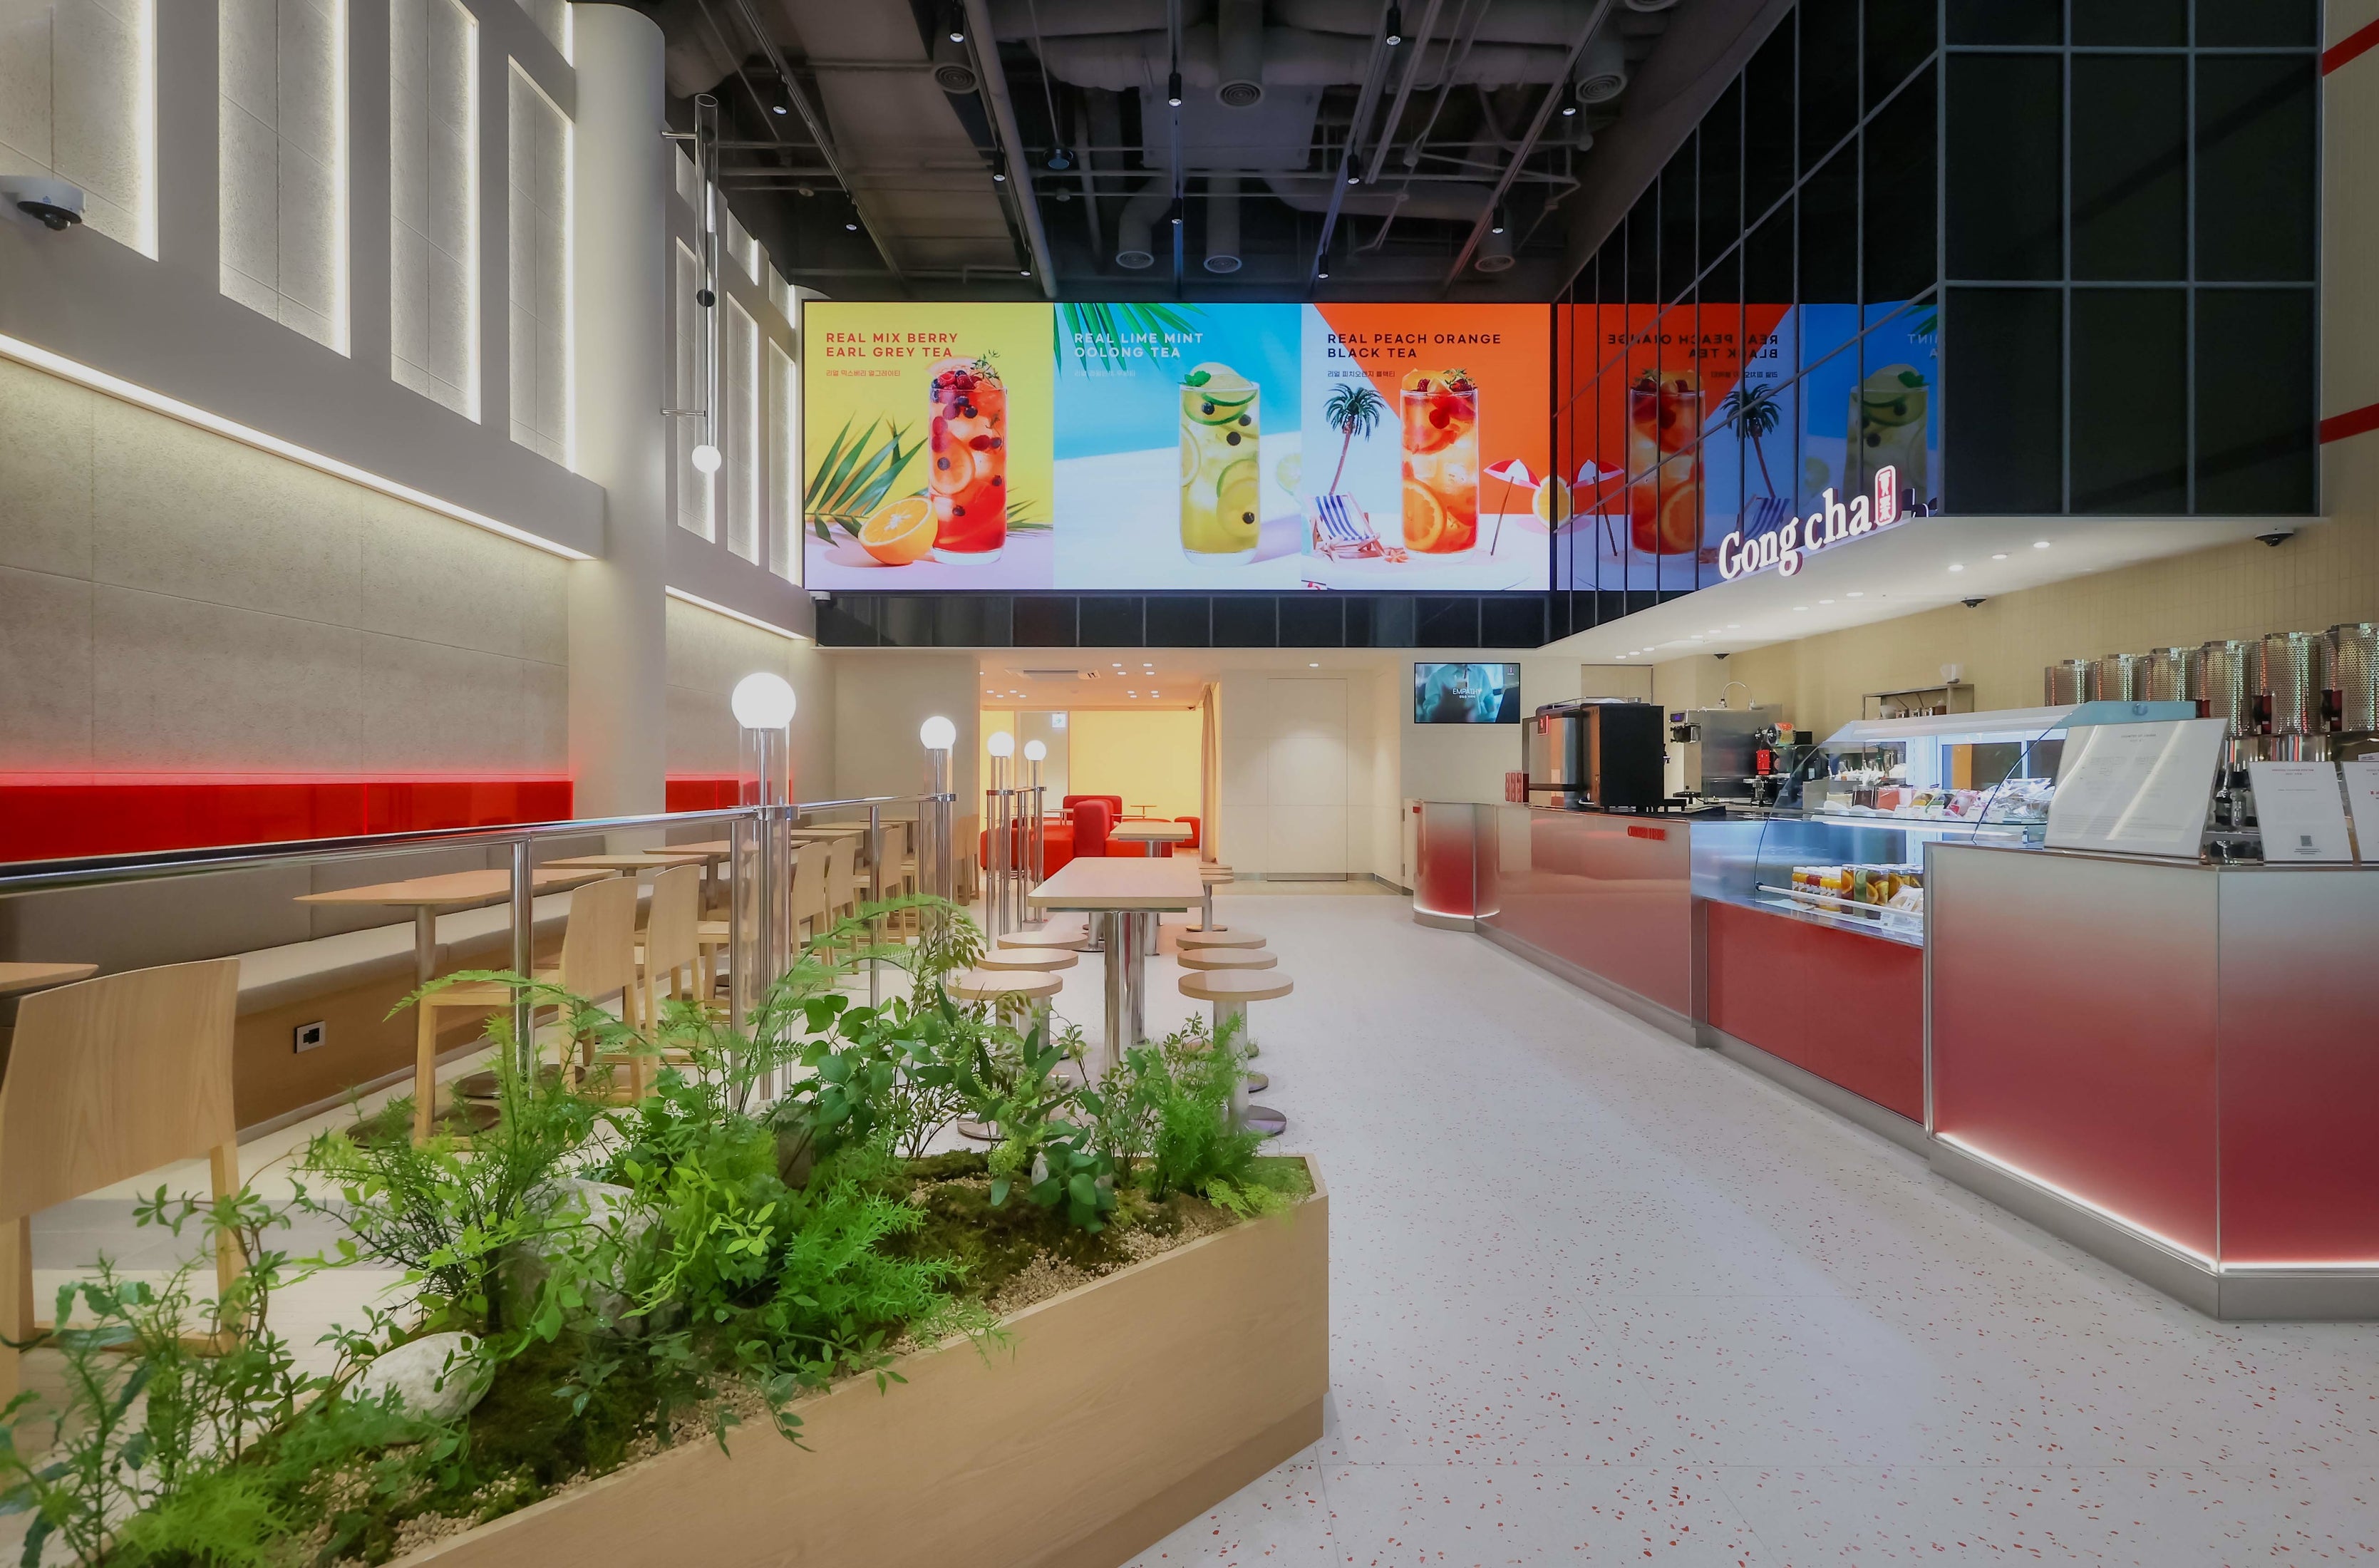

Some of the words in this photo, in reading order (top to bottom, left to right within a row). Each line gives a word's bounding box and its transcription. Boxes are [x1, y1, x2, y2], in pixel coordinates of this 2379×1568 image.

[826, 333, 866, 343] REAL
[873, 333, 900, 343] MIX
[907, 333, 958, 343] BERRY
[1074, 333, 1114, 344] REAL
[1121, 333, 1157, 344] LIME
[1165, 333, 1204, 344] MINT
[1328, 334, 1367, 344] REAL
[1375, 334, 1427, 344] PEACH
[1434, 334, 1501, 344] ORANGE
[826, 347, 866, 357] EARL
[873, 347, 914, 357] GREY
[922, 347, 952, 357] TEA
[1074, 347, 1144, 358] OOLONG
[1150, 347, 1180, 358] TEA
[1328, 348, 1380, 358] BLACK
[1388, 348, 1417, 358] TEA
[1718, 516, 1800, 579] Gong
[1804, 488, 1872, 550] cha
